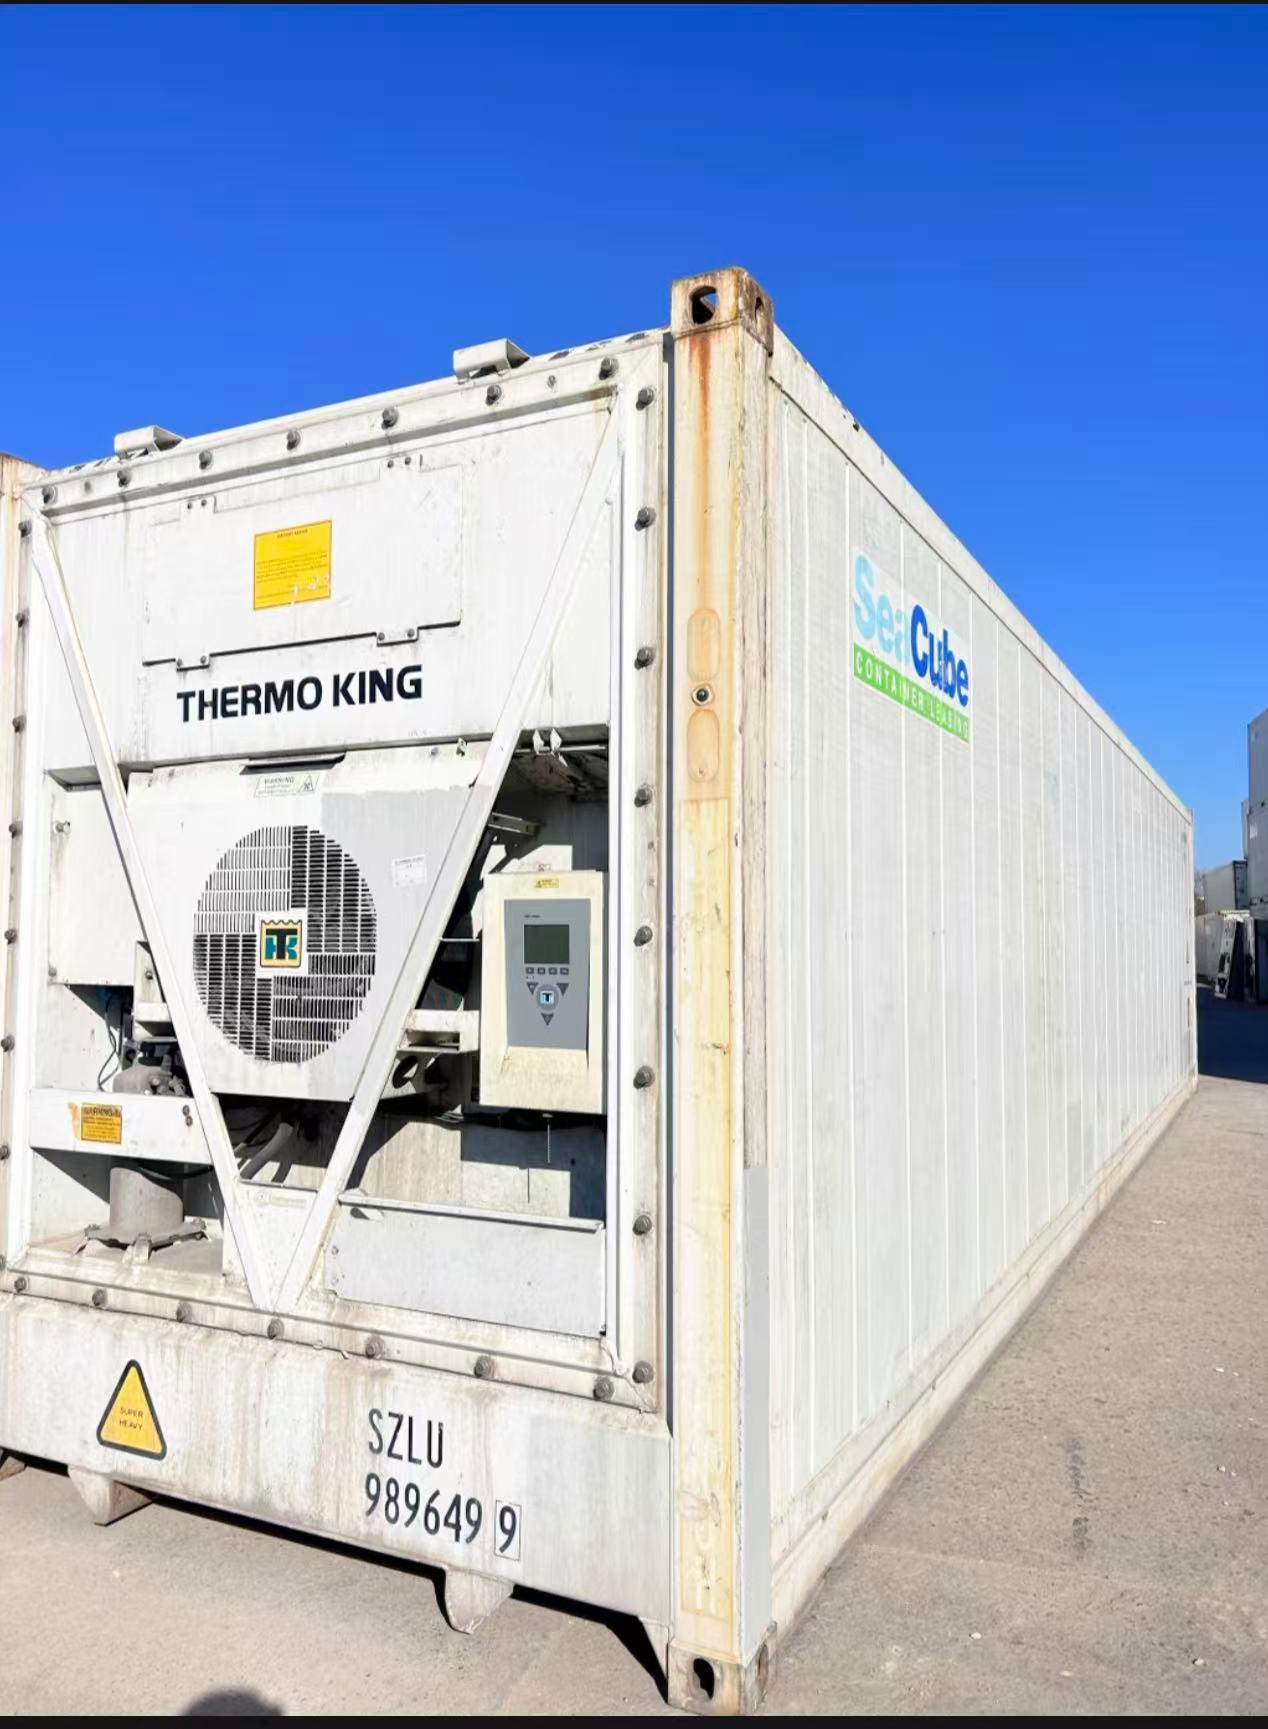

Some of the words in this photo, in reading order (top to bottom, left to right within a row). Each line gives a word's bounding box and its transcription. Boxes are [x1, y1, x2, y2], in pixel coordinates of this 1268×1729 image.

[854, 554, 968, 707] SeaCube
[176, 675, 323, 723] THERMO
[332, 664, 422, 708] KING
[856, 651, 925, 710] CONTAINER
[119, 1420, 143, 1431] HEAVY
[120, 1407, 143, 1418] SUPER
[368, 1408, 444, 1469] SZLU
[365, 1472, 483, 1544] 989649
[499, 1505, 517, 1554] 9
